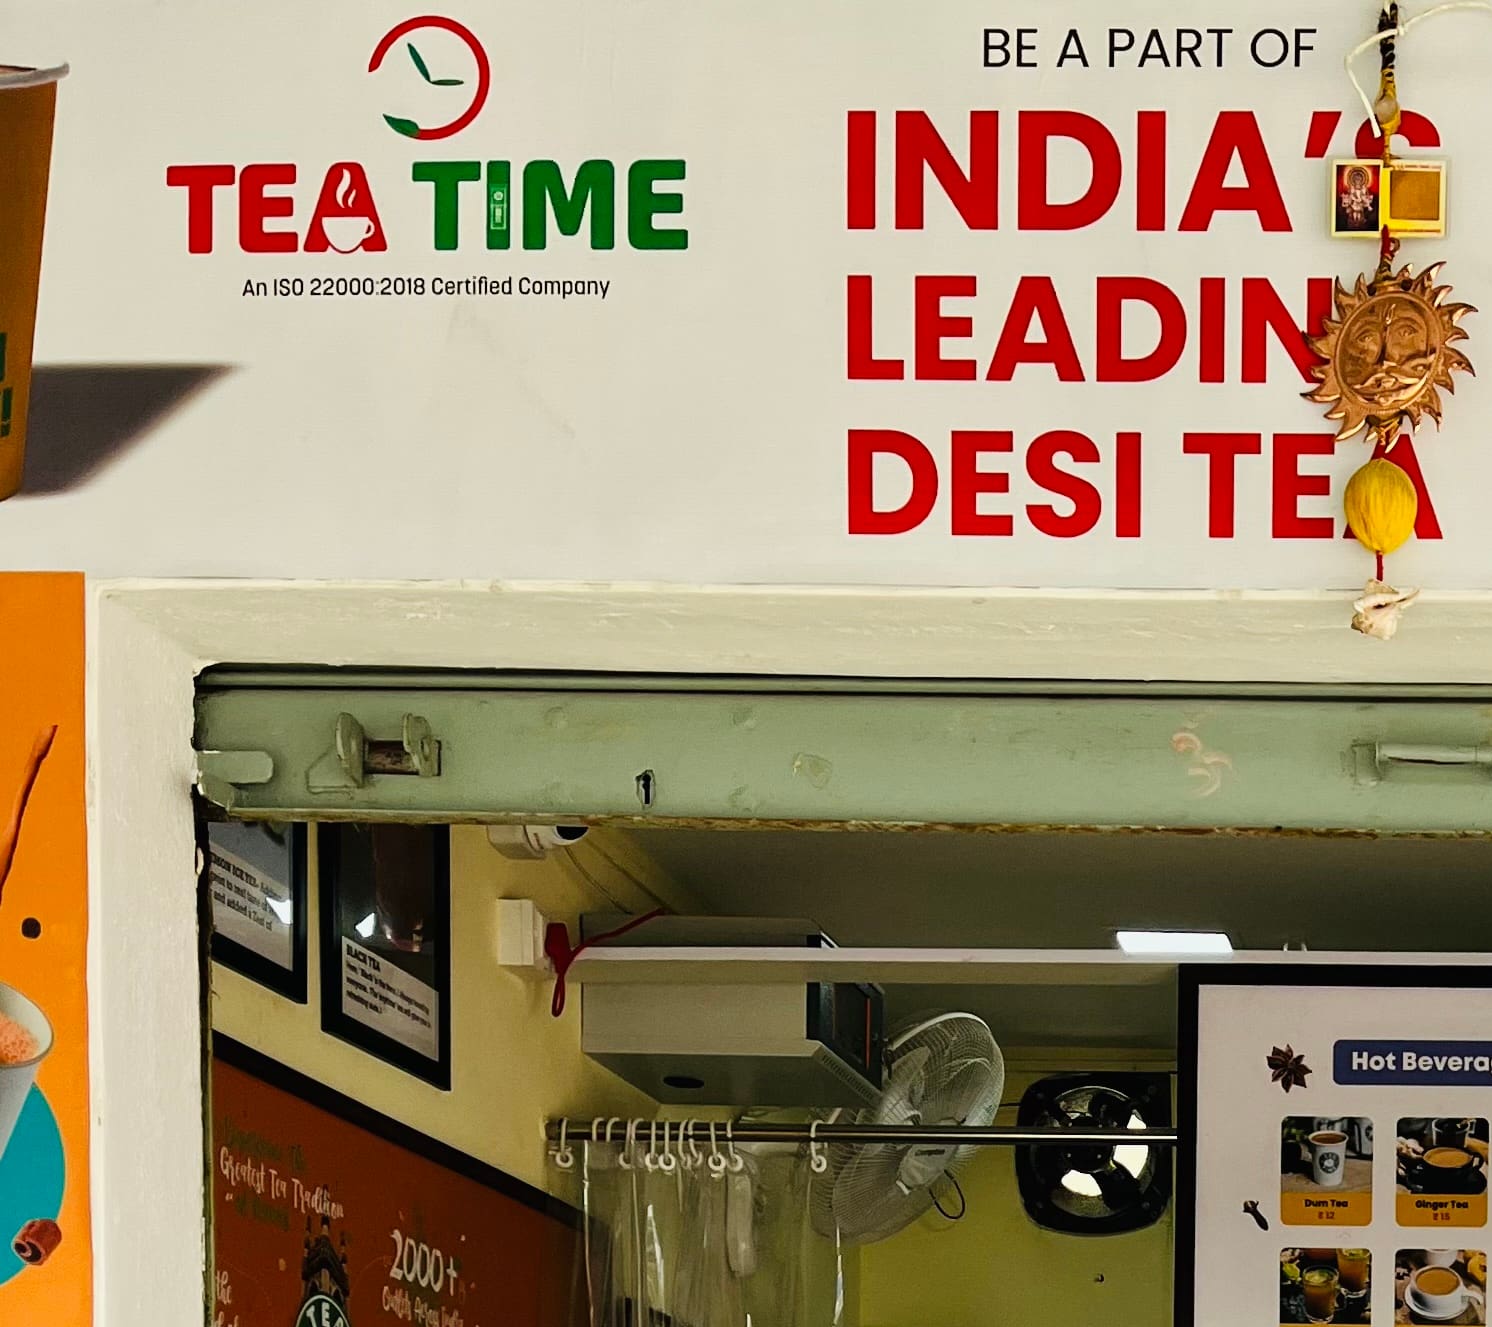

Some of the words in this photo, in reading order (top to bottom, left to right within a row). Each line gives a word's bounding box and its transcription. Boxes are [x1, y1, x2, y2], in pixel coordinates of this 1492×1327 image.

[984, 29, 1037, 68] BE
[1057, 29, 1088, 68] A
[1109, 29, 1232, 68] PART
[1251, 28, 1317, 68] OF
[167, 162, 387, 253] TEA
[412, 159, 688, 250] TIME
[242, 279, 267, 297] An
[274, 279, 304, 295] ISO
[310, 278, 425, 295] 22000:2018
[431, 276, 512, 295] Certified
[518, 277, 609, 299] Company
[847, 275, 1334, 384] LEADIN
[848, 429, 1142, 538] DESI
[1352, 1052, 1395, 1071] Hot
[1304, 1199, 1326, 1208] Dum
[1330, 1199, 1348, 1208] Tea
[1415, 1200, 1446, 1211] Ginger
[1450, 1200, 1468, 1209] Tea
